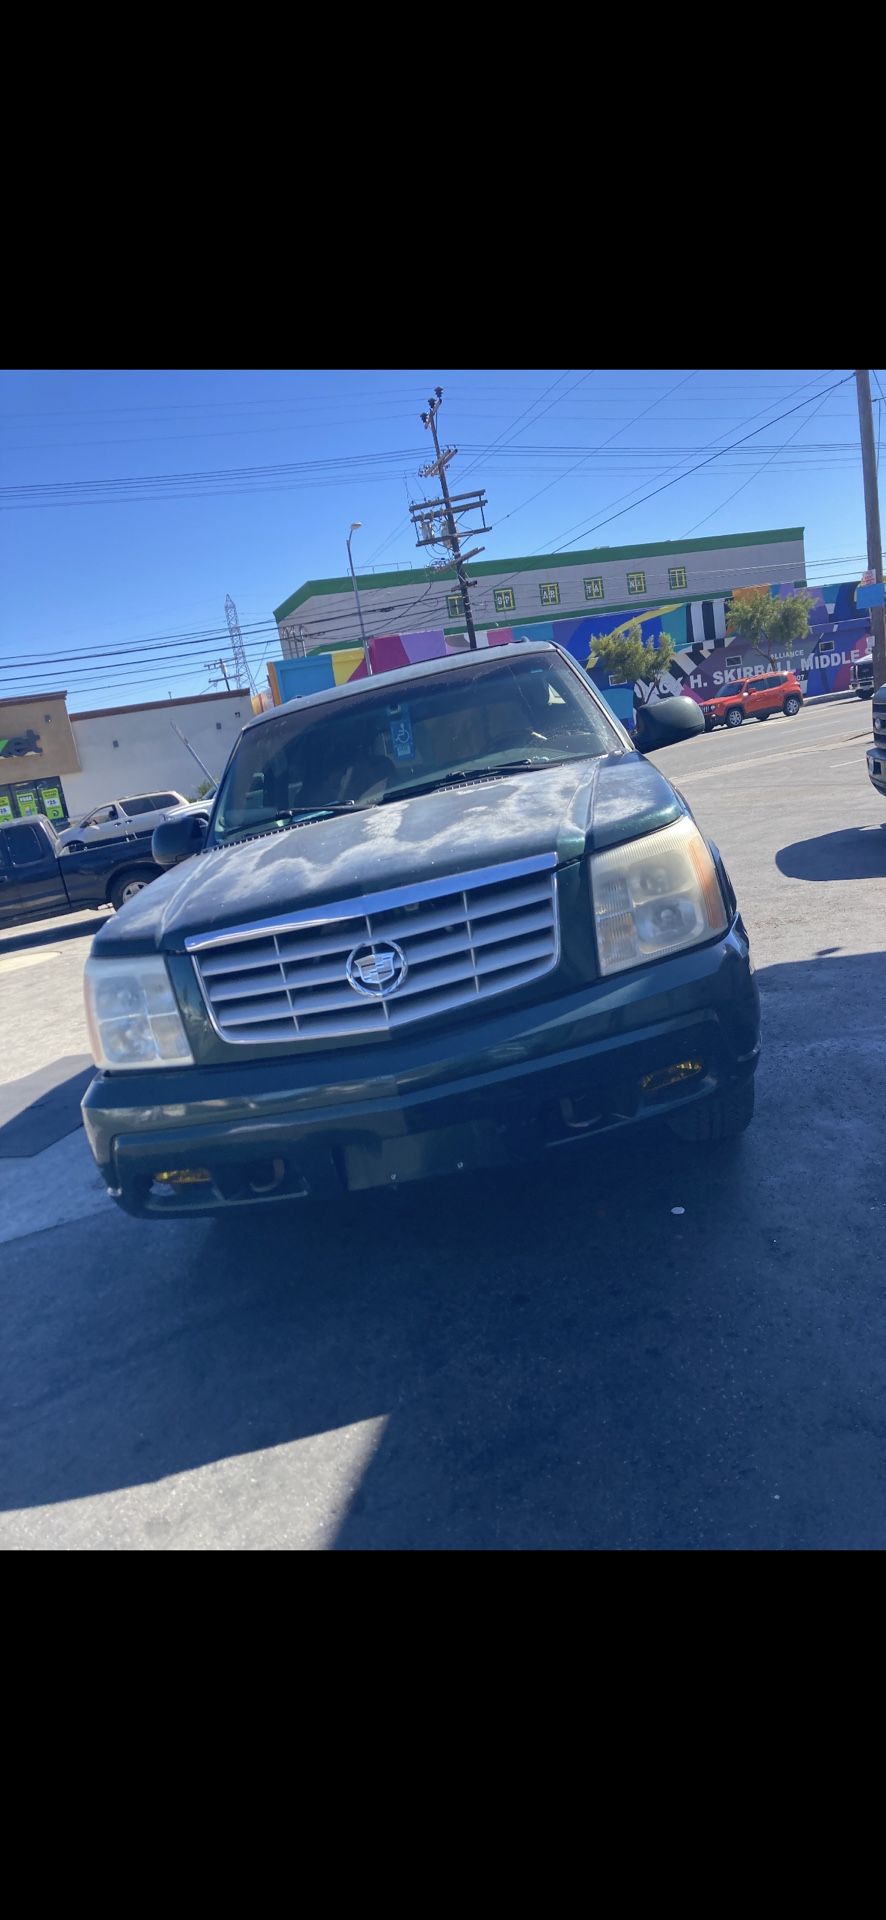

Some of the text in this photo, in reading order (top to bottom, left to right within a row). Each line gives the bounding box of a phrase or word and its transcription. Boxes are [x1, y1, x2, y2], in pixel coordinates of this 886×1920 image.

[690, 674, 708, 689] H.
[712, 660, 797, 685] SKIRBALL
[800, 649, 860, 671] MIDDLE
